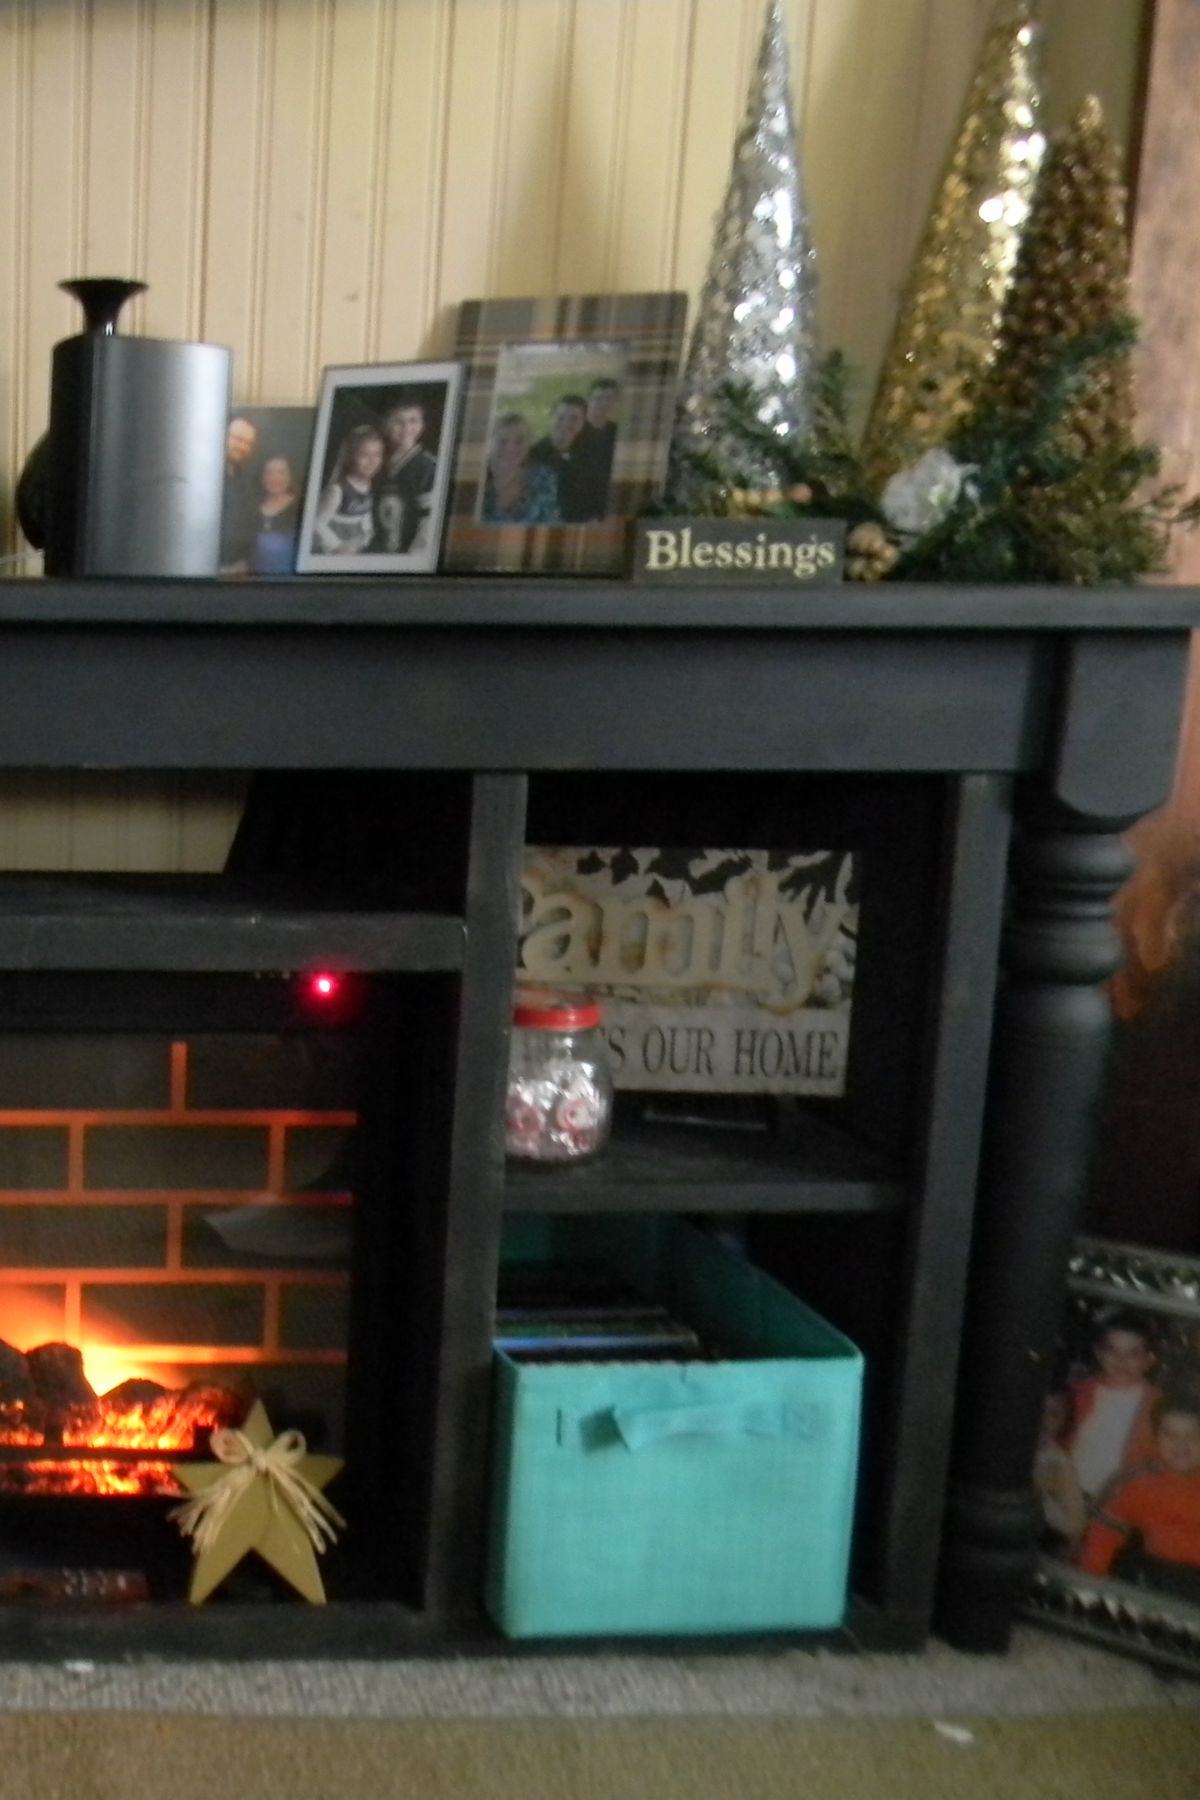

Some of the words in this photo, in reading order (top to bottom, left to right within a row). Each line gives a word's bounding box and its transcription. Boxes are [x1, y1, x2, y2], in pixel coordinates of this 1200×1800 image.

[645, 527, 836, 579] Blessings
[516, 868, 846, 1016] amily
[642, 1024, 716, 1076] OUR
[733, 1027, 839, 1080] HOME
